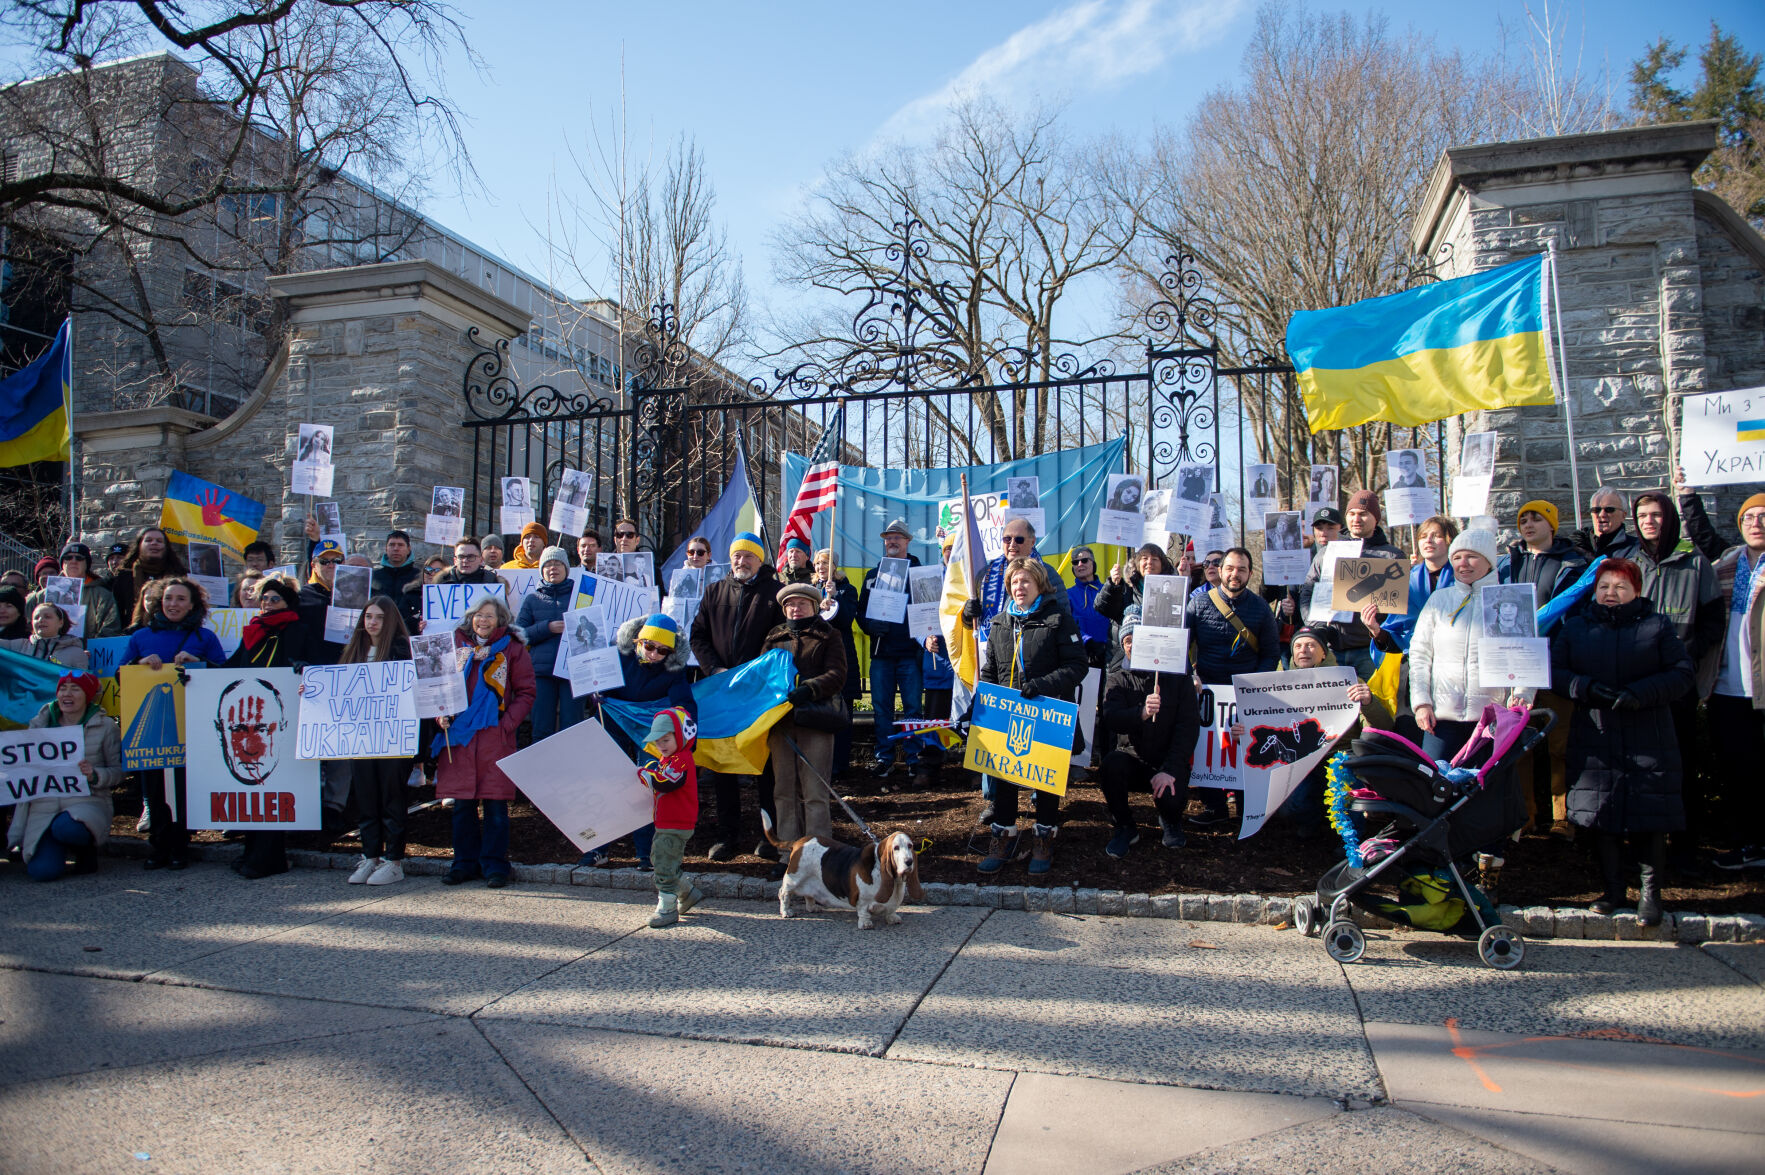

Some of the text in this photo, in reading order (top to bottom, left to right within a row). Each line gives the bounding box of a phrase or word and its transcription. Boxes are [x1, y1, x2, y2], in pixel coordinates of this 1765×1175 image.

[948, 496, 997, 526] SOP
[1340, 561, 1371, 580] NO
[209, 610, 256, 639] STAN
[303, 662, 415, 698] STAND
[1239, 683, 1293, 694] Terrorists
[1315, 679, 1352, 689] attack
[329, 694, 399, 722] WITH
[979, 693, 1072, 727] WE STAND WITH
[1243, 706, 1285, 716] Ukraine
[1286, 705, 1316, 714] every
[300, 719, 417, 759] UKRAINE
[1, 741, 77, 765] STOP
[124, 747, 154, 758] WITH
[127, 759, 139, 768] IN
[141, 758, 164, 768] THE
[974, 748, 1057, 786] UKRAINE
[1190, 772, 1237, 783] SayNOtoPutin
[6, 775, 82, 799] WAR
[211, 792, 296, 822] KILLER
